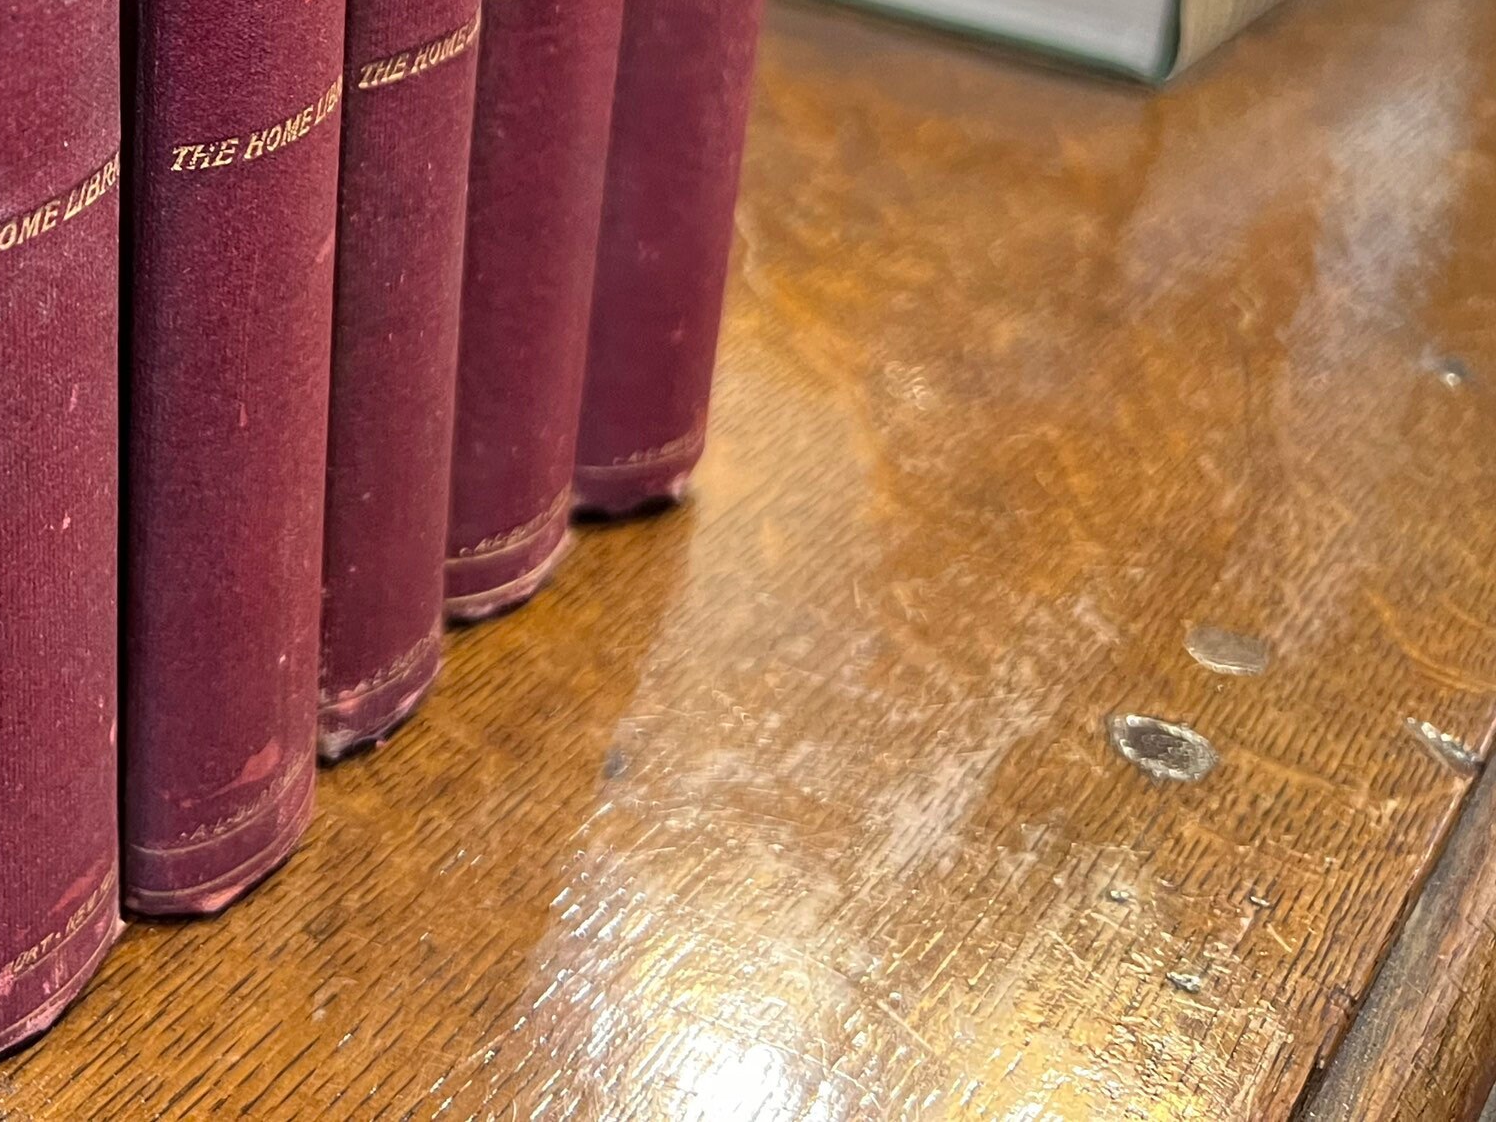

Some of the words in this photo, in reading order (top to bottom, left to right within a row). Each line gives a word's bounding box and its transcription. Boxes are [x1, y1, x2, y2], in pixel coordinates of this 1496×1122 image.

[358, 52, 409, 89] THE
[410, 23, 468, 74] HOME
[169, 136, 239, 172] THE
[242, 104, 314, 161] HOME
